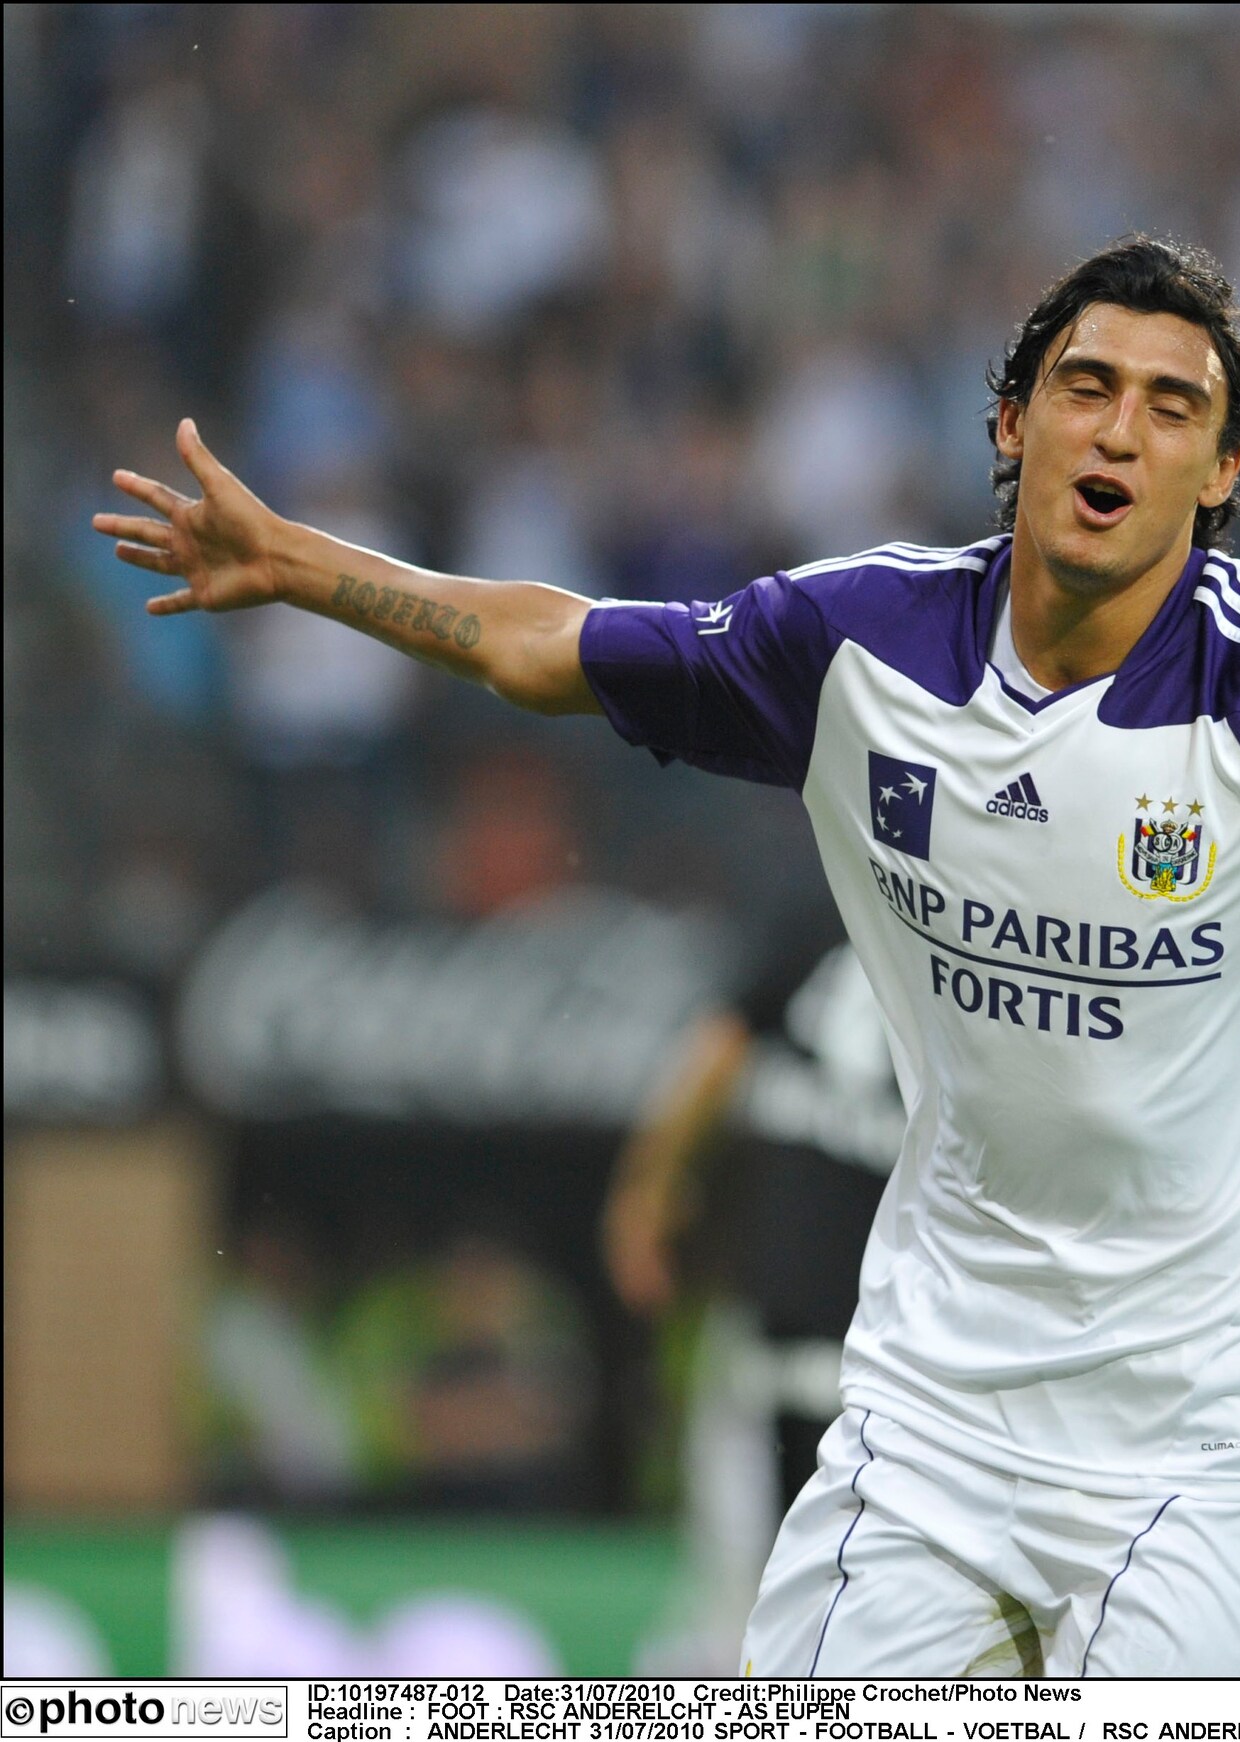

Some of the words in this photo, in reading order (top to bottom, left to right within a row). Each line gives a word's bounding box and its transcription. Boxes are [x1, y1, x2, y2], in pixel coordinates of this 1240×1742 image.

[985, 799, 1049, 823] adidas
[868, 856, 946, 928] BNP
[961, 897, 1225, 971] PARIBAS
[929, 953, 1125, 1041] FORTIS
